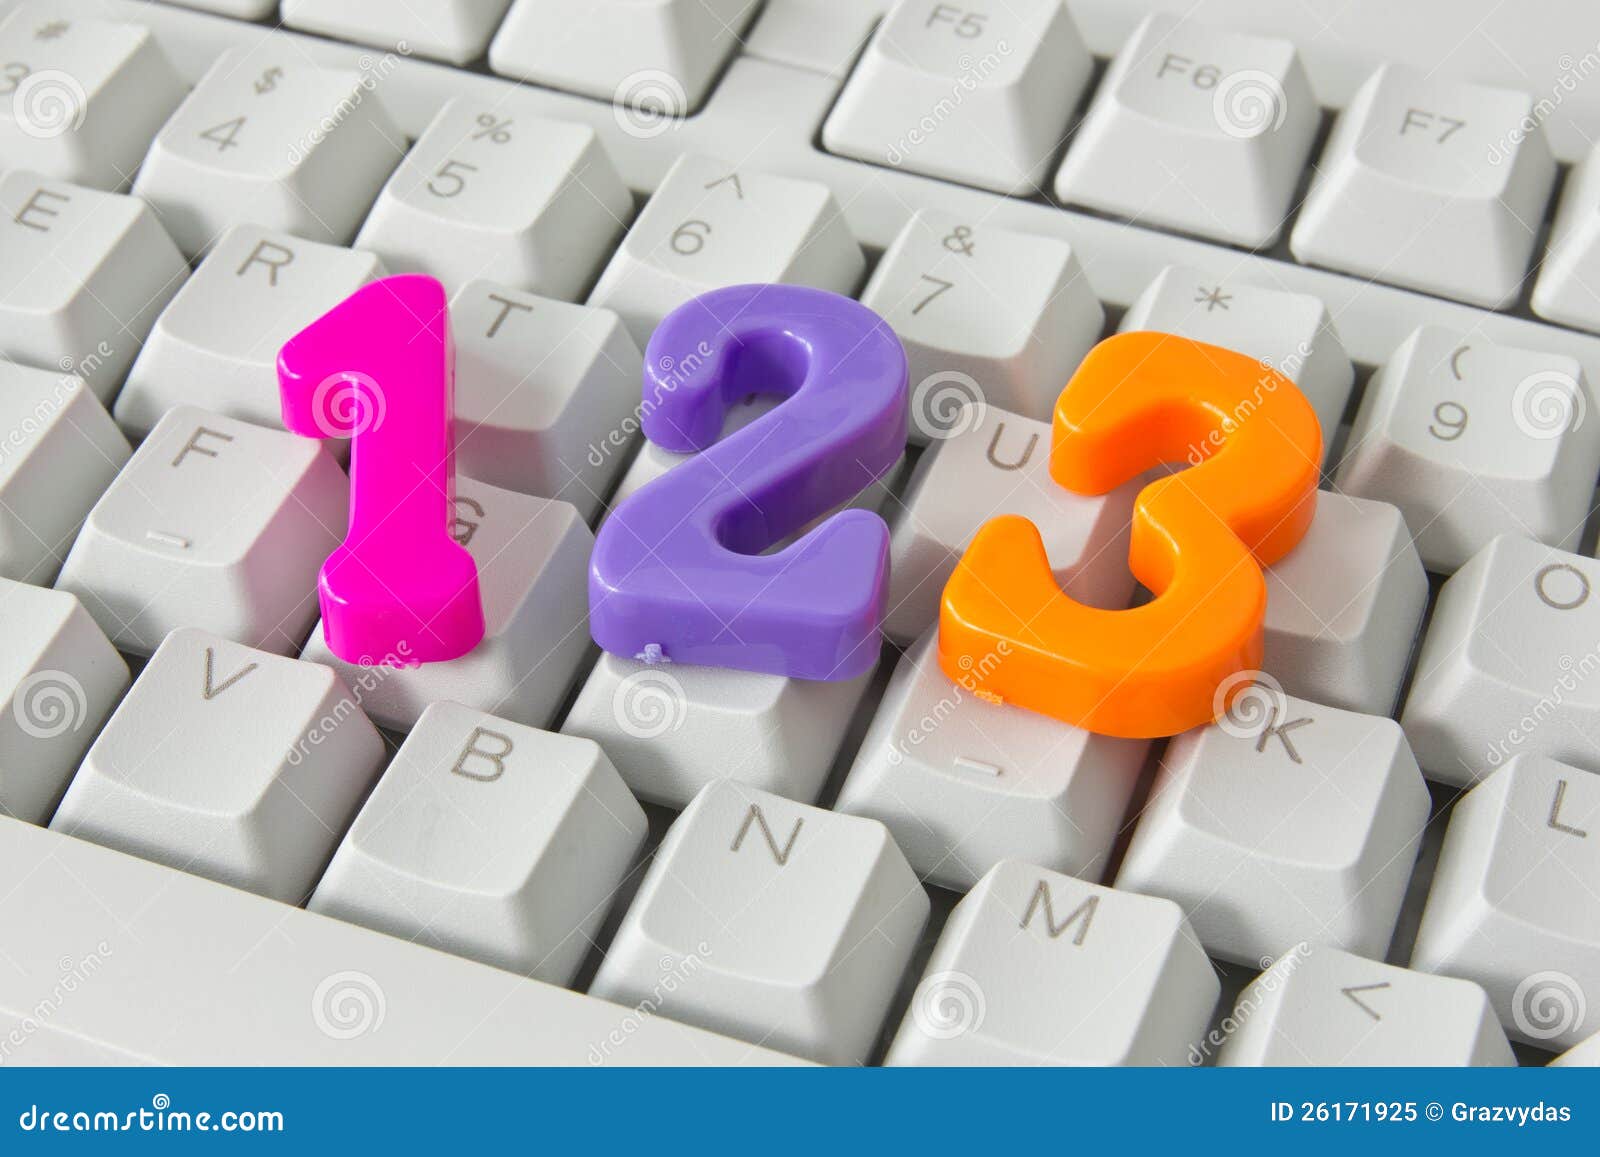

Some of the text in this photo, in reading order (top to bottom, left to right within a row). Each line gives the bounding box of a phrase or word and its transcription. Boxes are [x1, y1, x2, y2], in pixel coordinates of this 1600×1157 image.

[925, 4, 988, 40] F5
[253, 66, 284, 96] $
[1156, 53, 1222, 91] F6
[200, 116, 246, 152] 4
[472, 112, 514, 144] %
[1399, 107, 1466, 145] F7
[427, 160, 478, 198] 5
[14, 189, 69, 232] E
[670, 220, 711, 256] 6
[942, 226, 976, 257] &
[236, 240, 294, 287] R
[487, 293, 534, 338] T
[911, 274, 953, 316] 7
[1429, 400, 1469, 441] 9
[172, 426, 234, 467] F
[987, 422, 1039, 471] U
[278, 273, 1322, 738] 1 2 3
[1534, 563, 1590, 609] O
[204, 647, 258, 700] V
[451, 726, 513, 782] B
[1256, 706, 1314, 764] K
[1548, 779, 1587, 838] L
[730, 803, 804, 866] N
[1019, 879, 1100, 946] M
